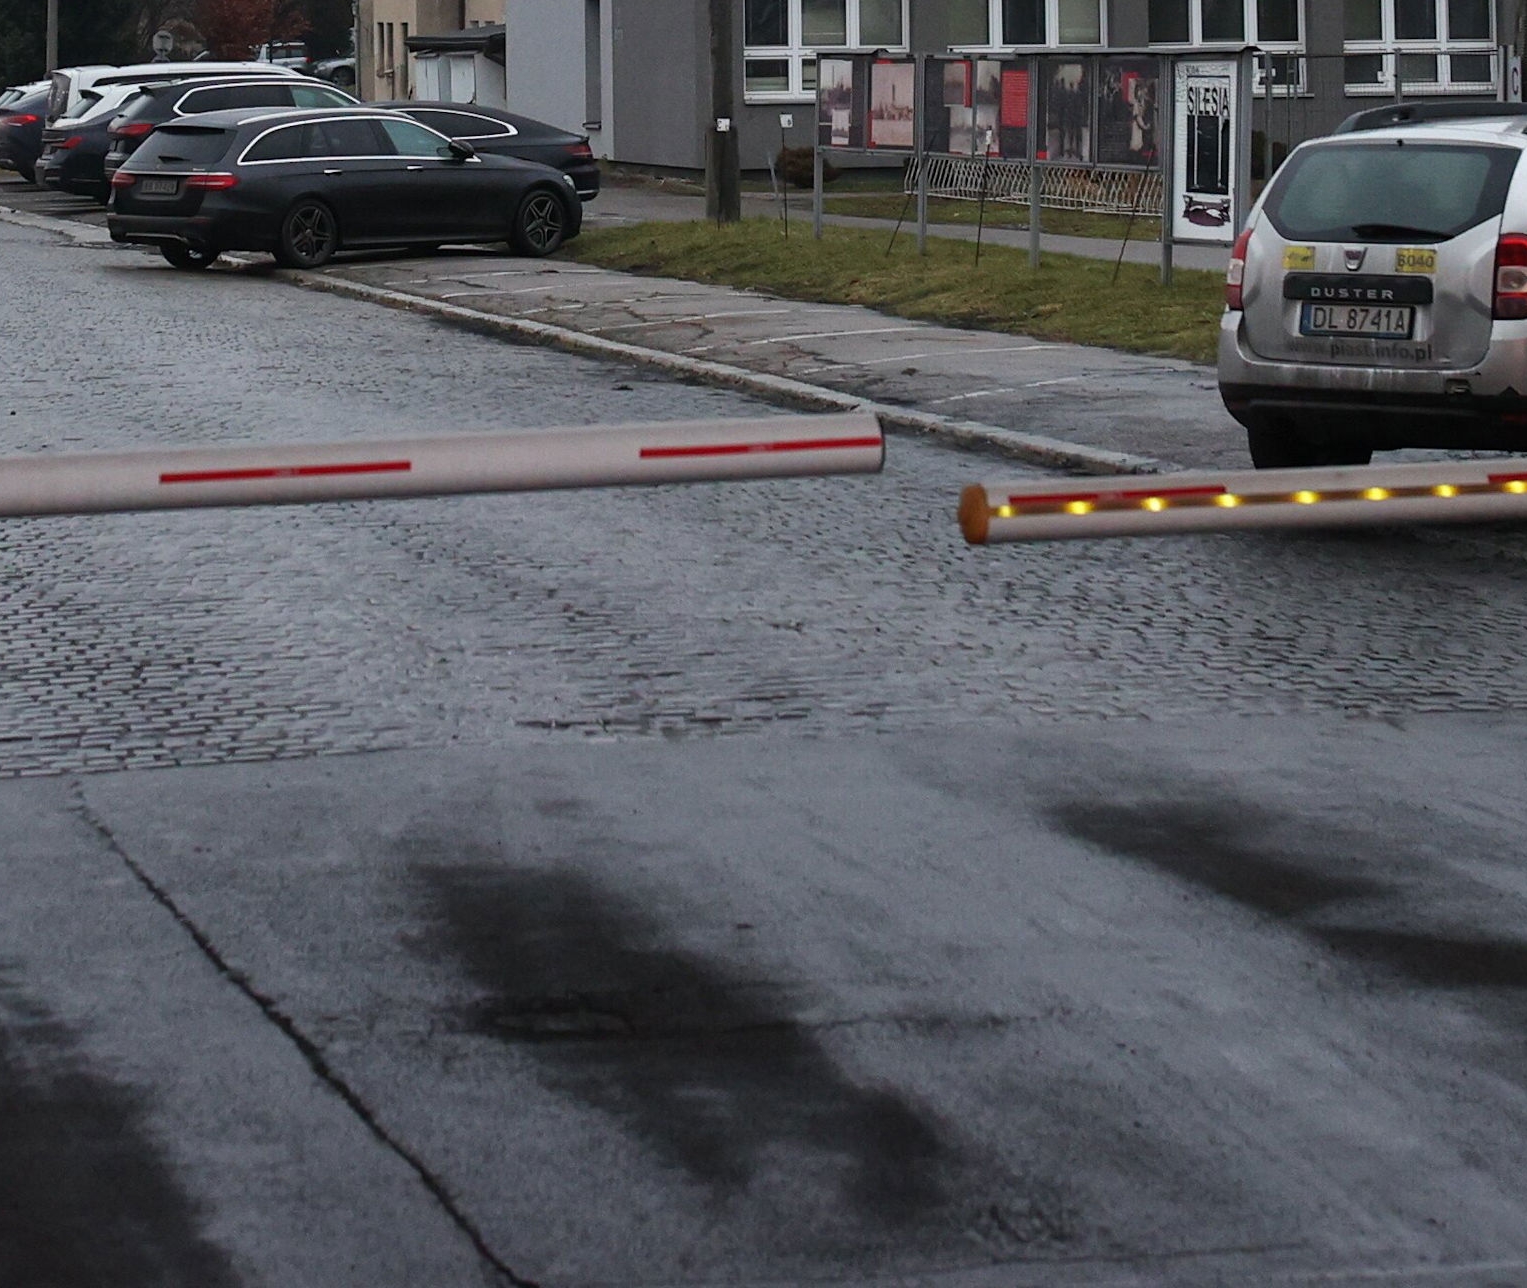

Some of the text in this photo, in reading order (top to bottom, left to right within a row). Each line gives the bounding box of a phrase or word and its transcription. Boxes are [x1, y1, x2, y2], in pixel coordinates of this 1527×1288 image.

[1186, 86, 1231, 118] SILESIA
[1310, 287, 1394, 300] DUSTER
[1312, 306, 1406, 332] DL 8741A
